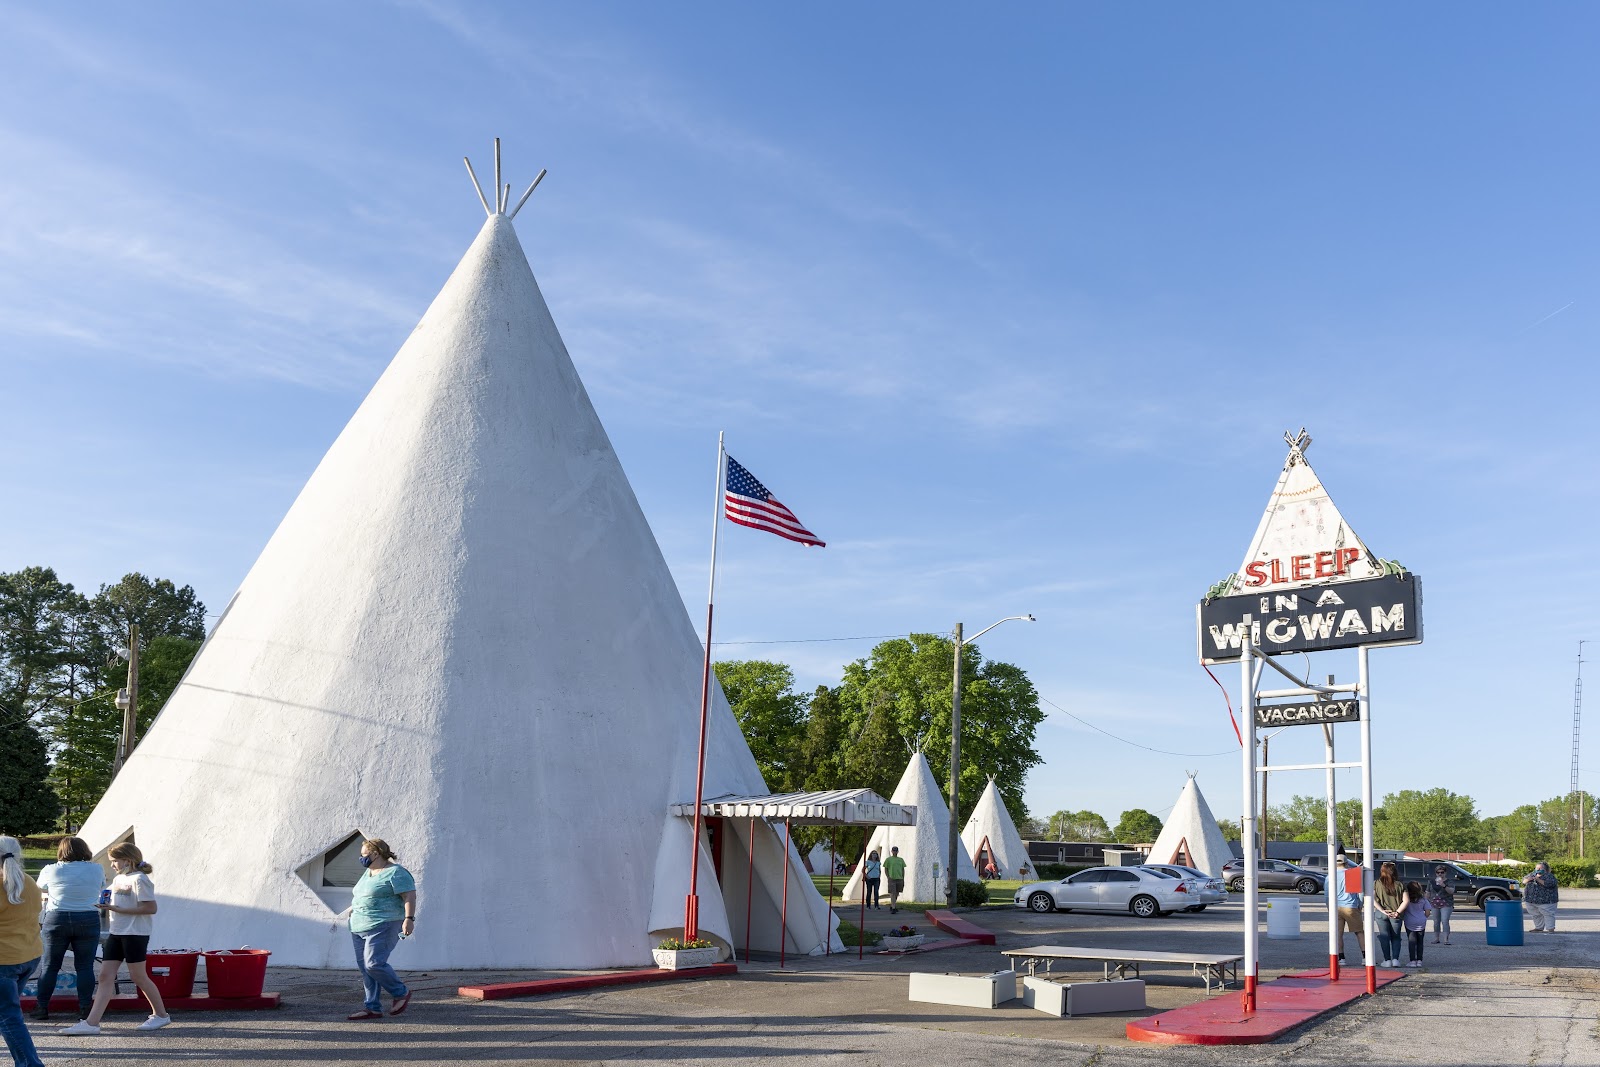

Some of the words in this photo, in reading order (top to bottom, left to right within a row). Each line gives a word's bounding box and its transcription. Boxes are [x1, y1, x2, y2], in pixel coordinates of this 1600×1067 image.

[1245, 548, 1359, 587] SLEEP
[1260, 594, 1297, 613] IN
[1316, 590, 1344, 607] A
[1209, 603, 1404, 650] WIGWAM
[1258, 702, 1351, 722] VACANCY
[857, 803, 876, 820] GIFT
